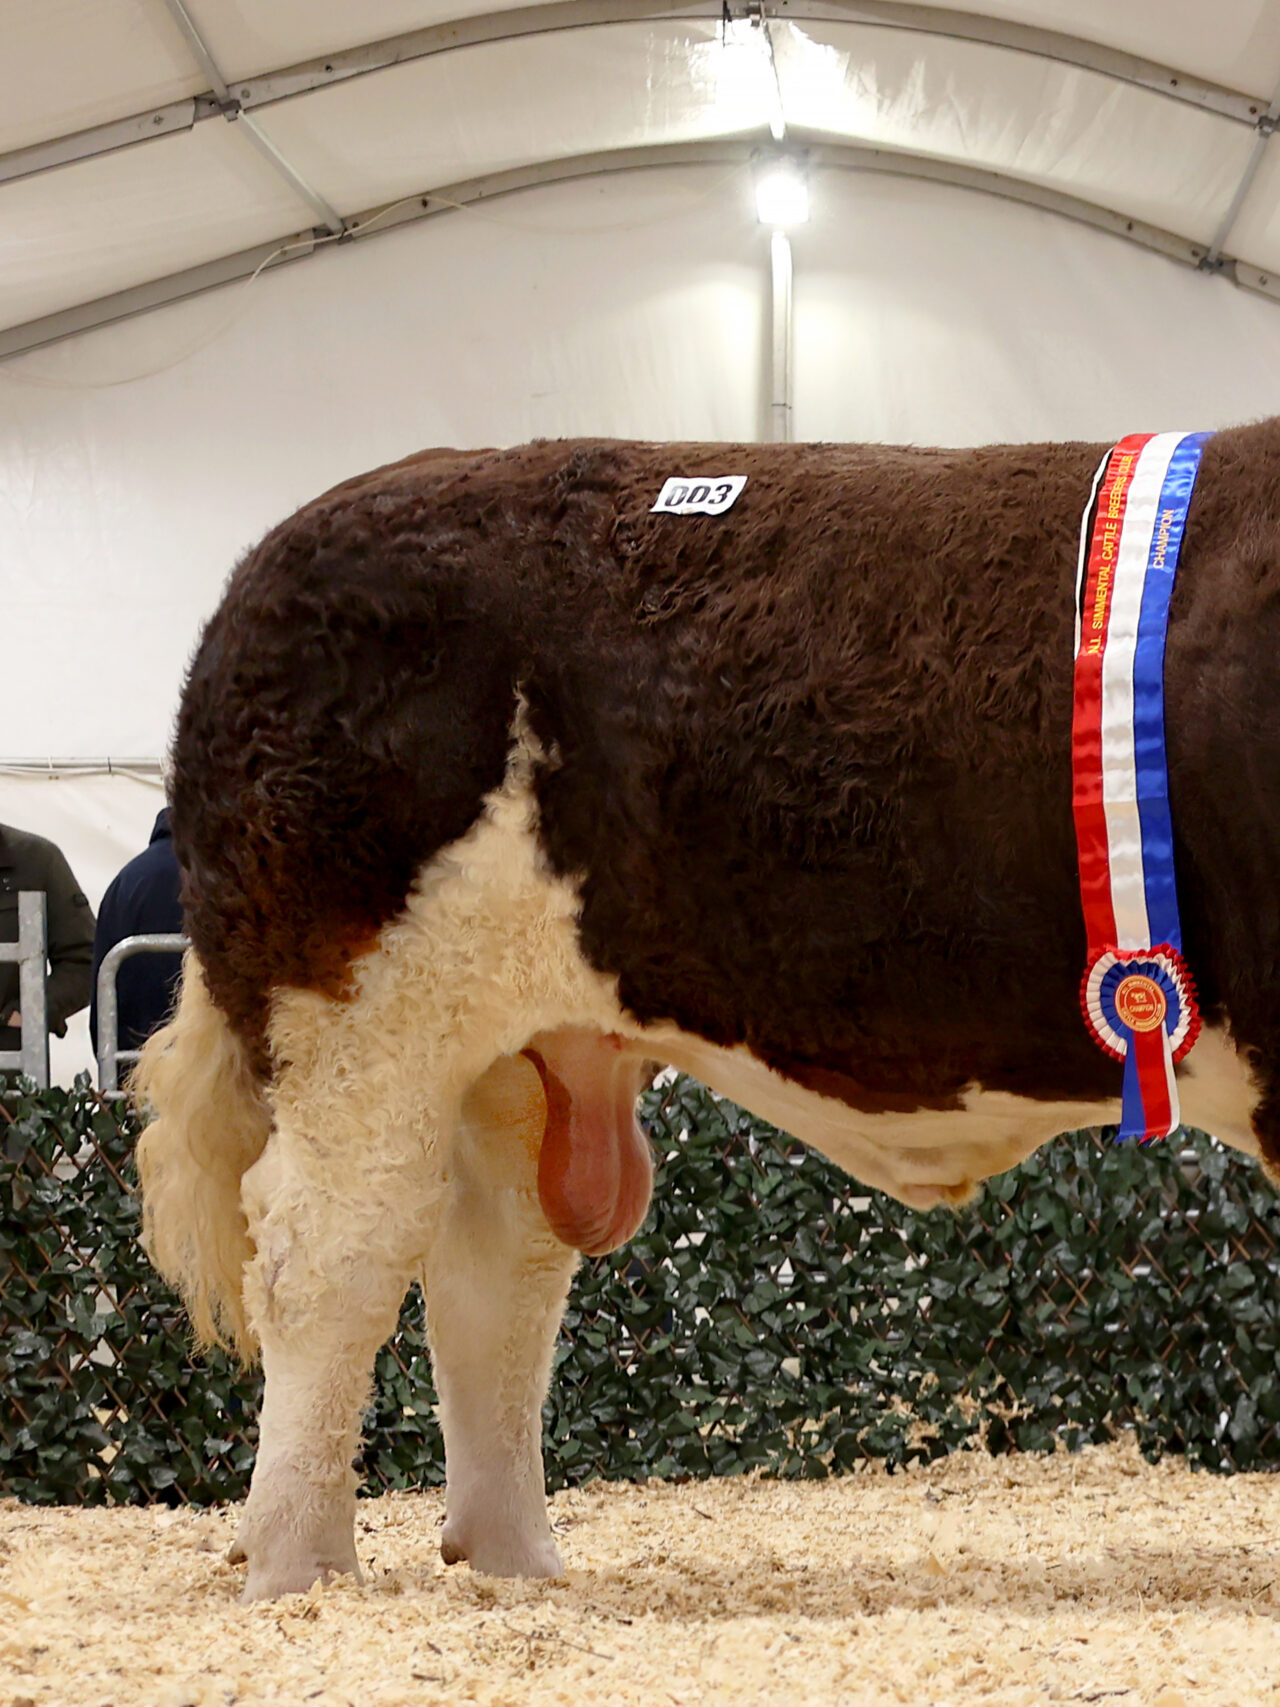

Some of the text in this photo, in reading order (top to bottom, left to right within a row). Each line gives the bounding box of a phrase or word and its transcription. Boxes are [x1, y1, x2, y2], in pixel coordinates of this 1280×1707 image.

[1092, 563, 1112, 630] SIMMENTAL
[1102, 522, 1117, 560] CATTLE
[1153, 508, 1175, 569] CHAMPION
